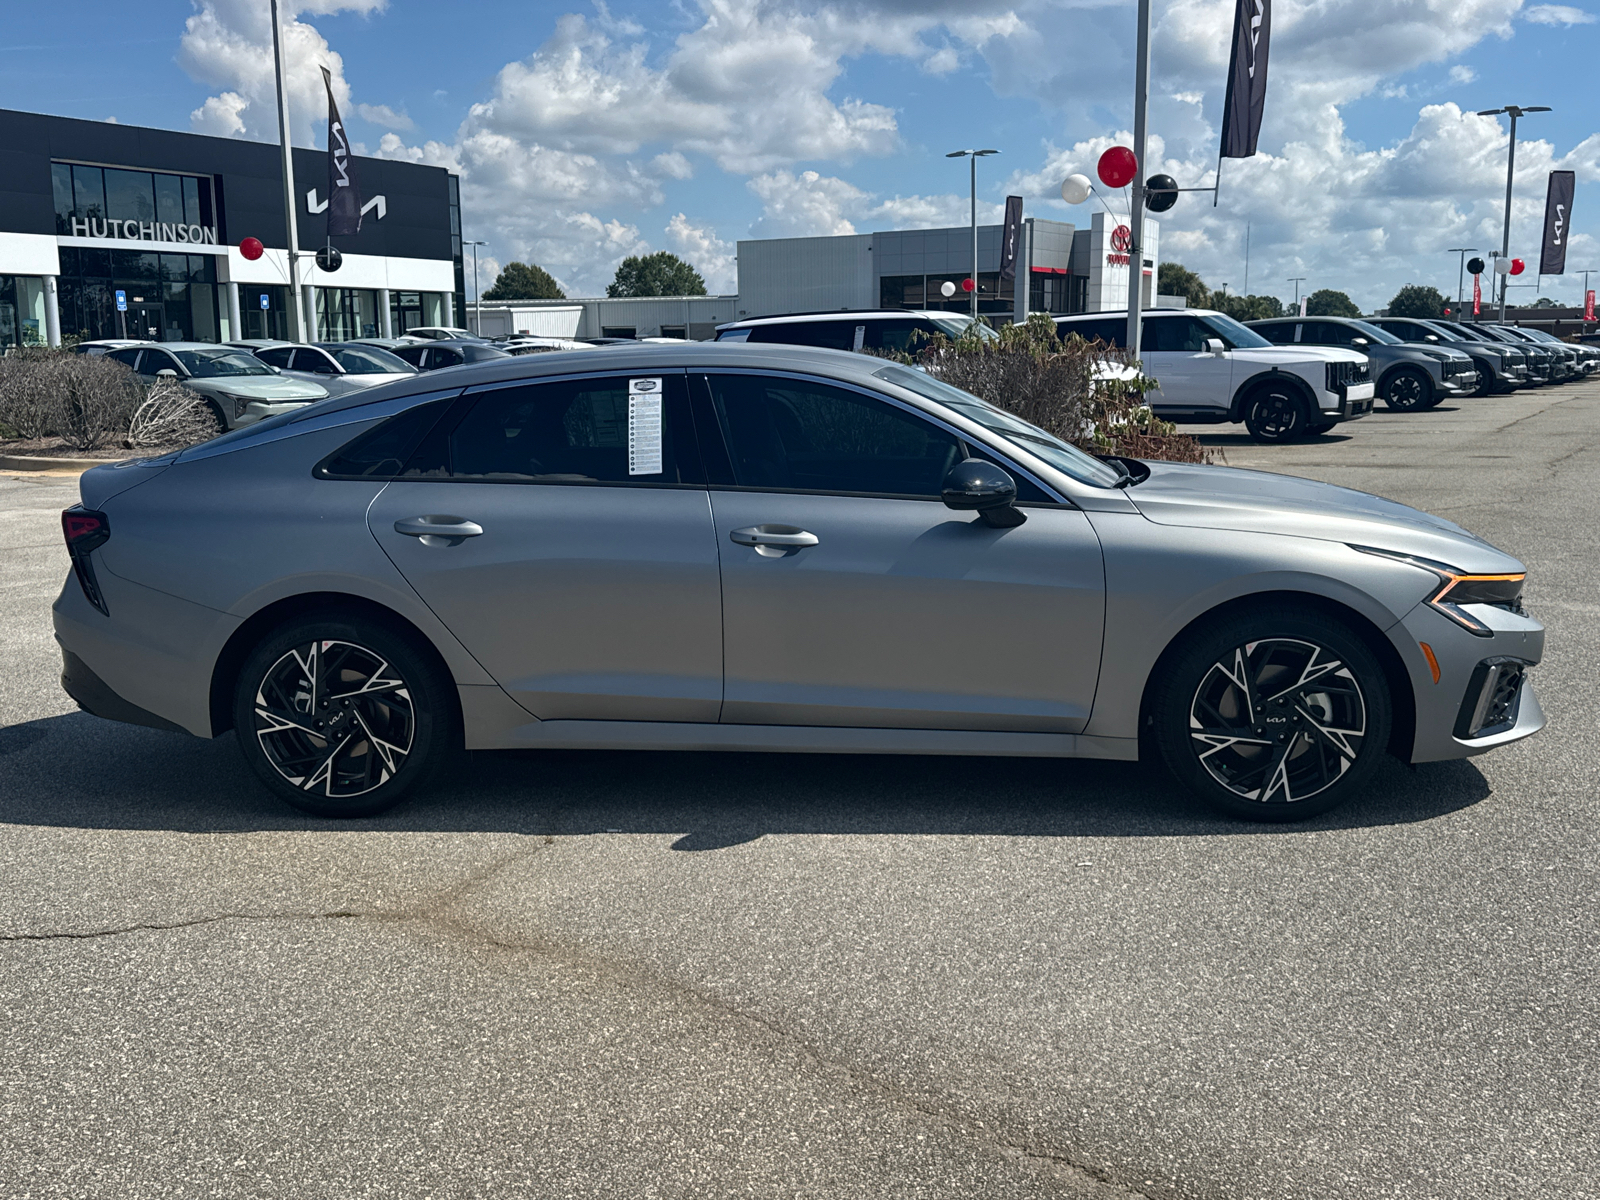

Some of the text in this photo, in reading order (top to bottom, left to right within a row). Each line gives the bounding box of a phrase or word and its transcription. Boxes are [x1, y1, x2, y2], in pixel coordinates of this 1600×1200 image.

[332, 122, 349, 187] KIA
[71, 216, 217, 245] HUTCHINSON
[1553, 204, 1565, 245] KIA
[1108, 254, 1131, 266] TOYOT
[328, 711, 344, 726] KIA
